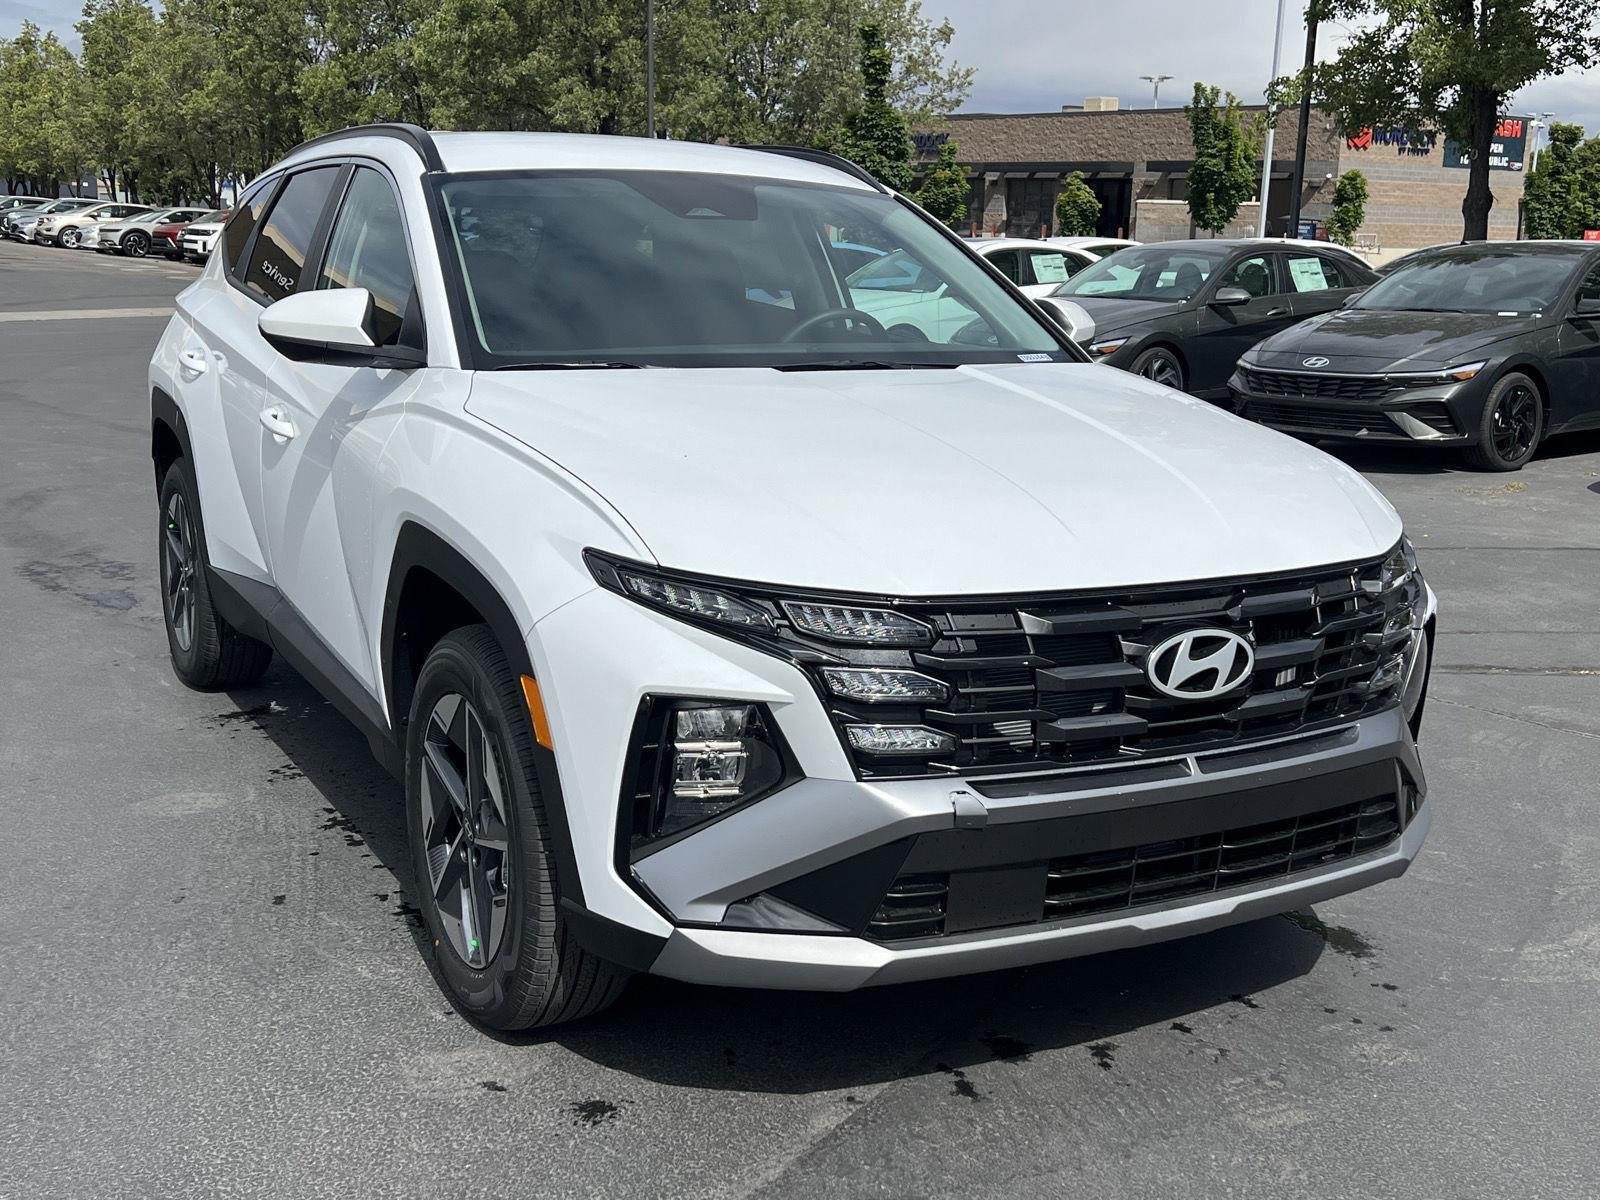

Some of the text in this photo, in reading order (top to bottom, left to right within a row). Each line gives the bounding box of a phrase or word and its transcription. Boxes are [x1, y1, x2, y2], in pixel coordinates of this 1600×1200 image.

[1493, 119, 1523, 138] ASH
[1489, 142, 1504, 153] PEN
[1488, 156, 1509, 167] UBLIC
